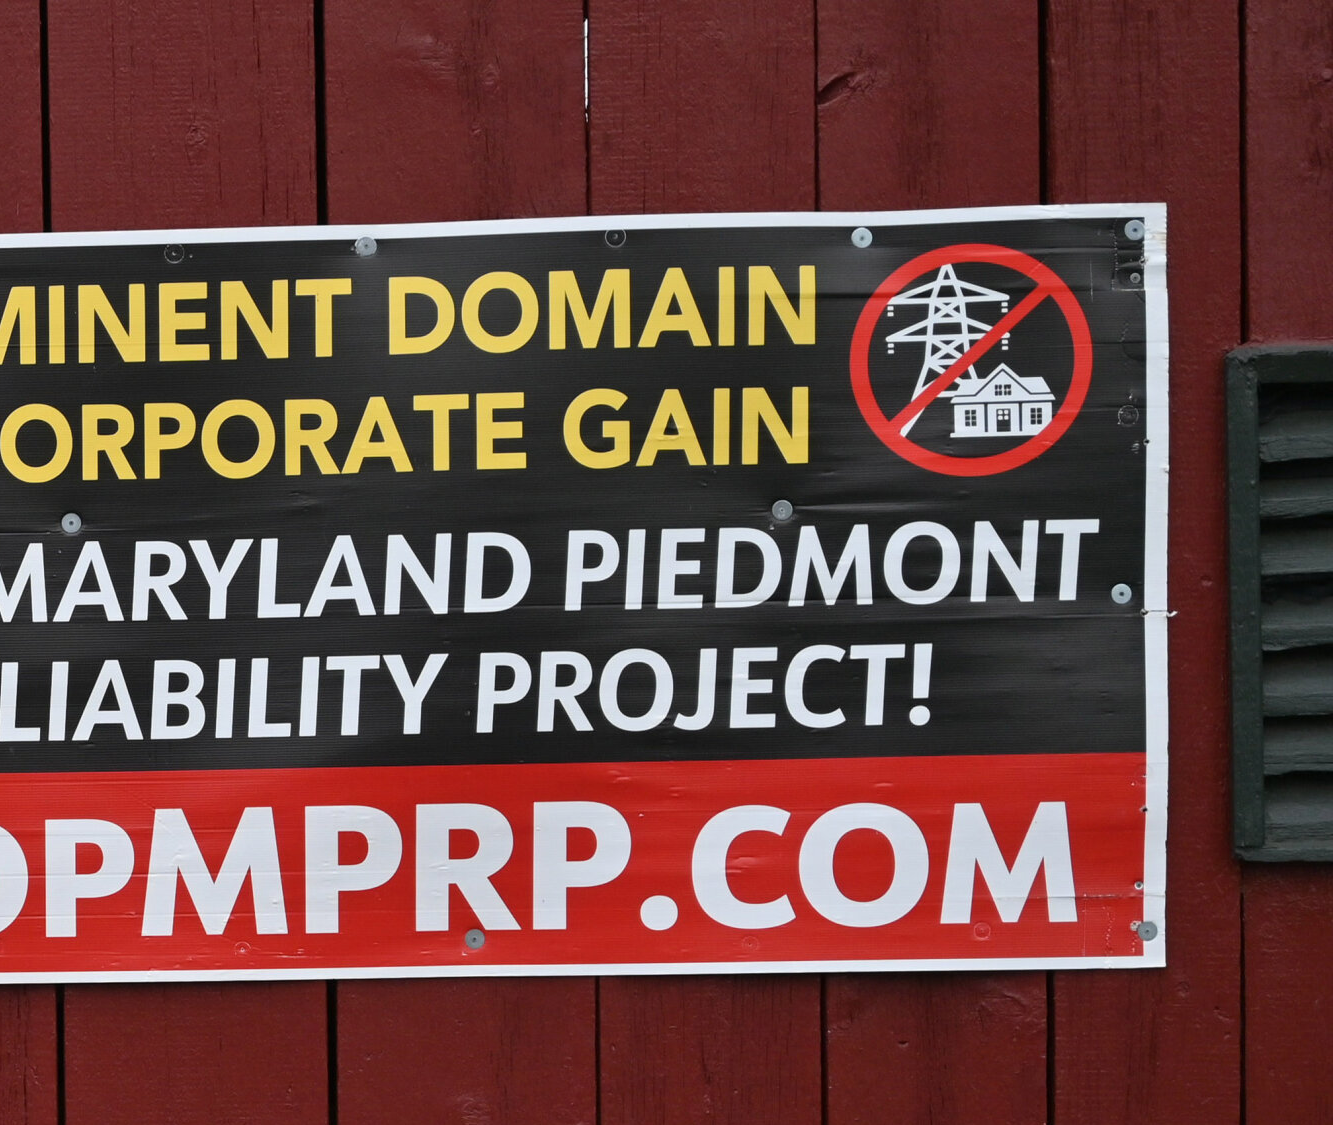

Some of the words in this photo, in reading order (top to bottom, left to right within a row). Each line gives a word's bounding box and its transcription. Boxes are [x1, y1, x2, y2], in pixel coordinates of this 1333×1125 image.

[388, 264, 817, 356] DOMAIN
[563, 386, 810, 470] GAIN
[564, 518, 1100, 611] PIEDMONT
[476, 641, 934, 734] PROJECT!
